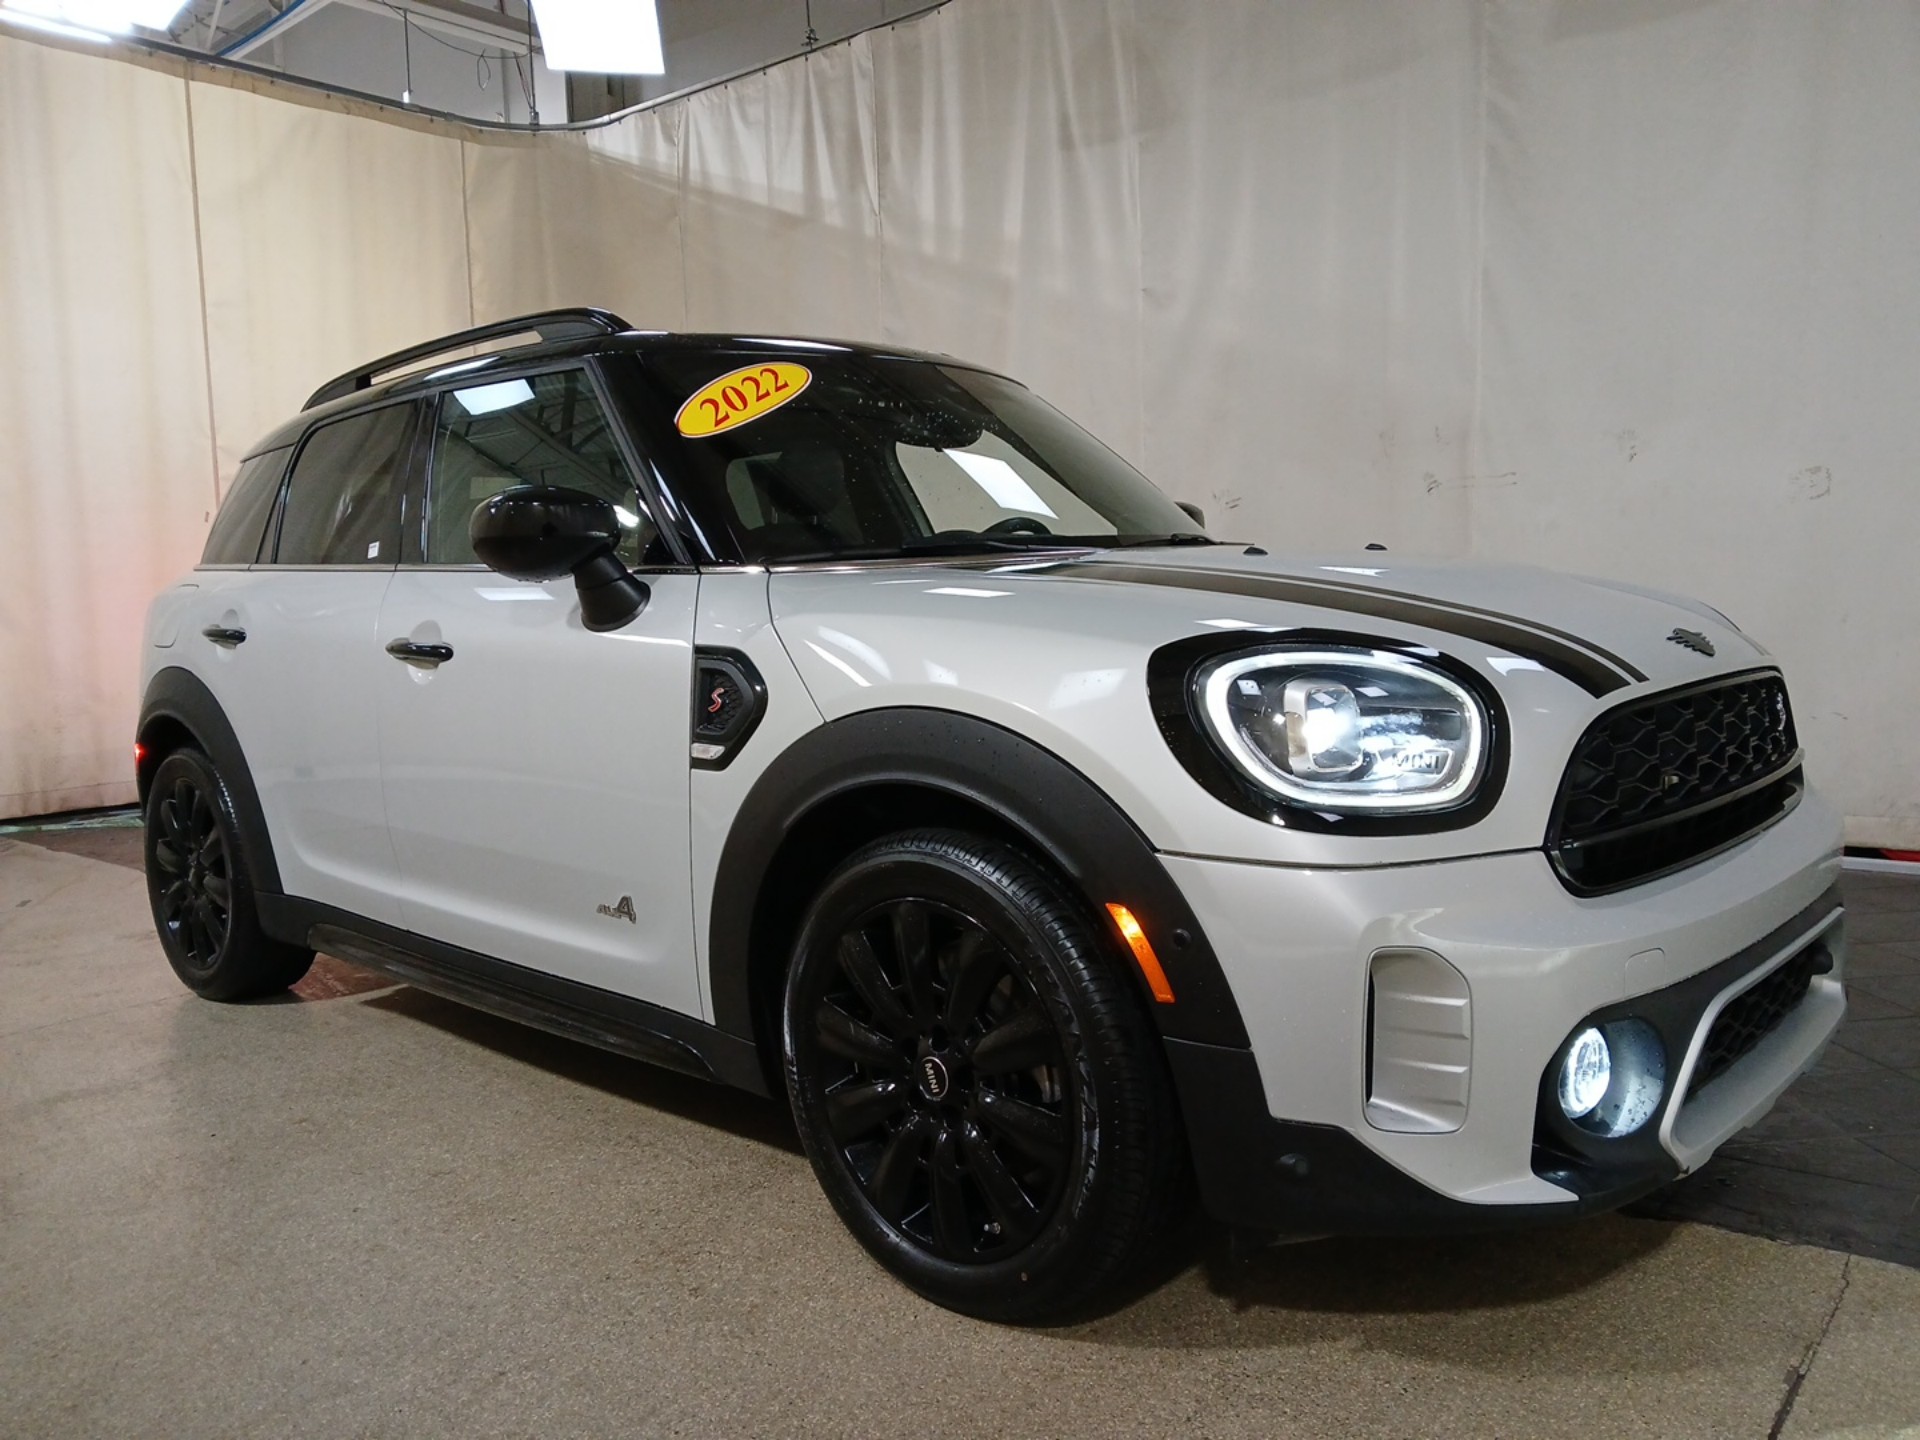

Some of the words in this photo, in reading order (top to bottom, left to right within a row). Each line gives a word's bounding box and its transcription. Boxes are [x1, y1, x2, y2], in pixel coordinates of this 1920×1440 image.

[699, 367, 790, 428] 2022
[707, 687, 725, 713] S
[924, 1062, 940, 1093] MINI
